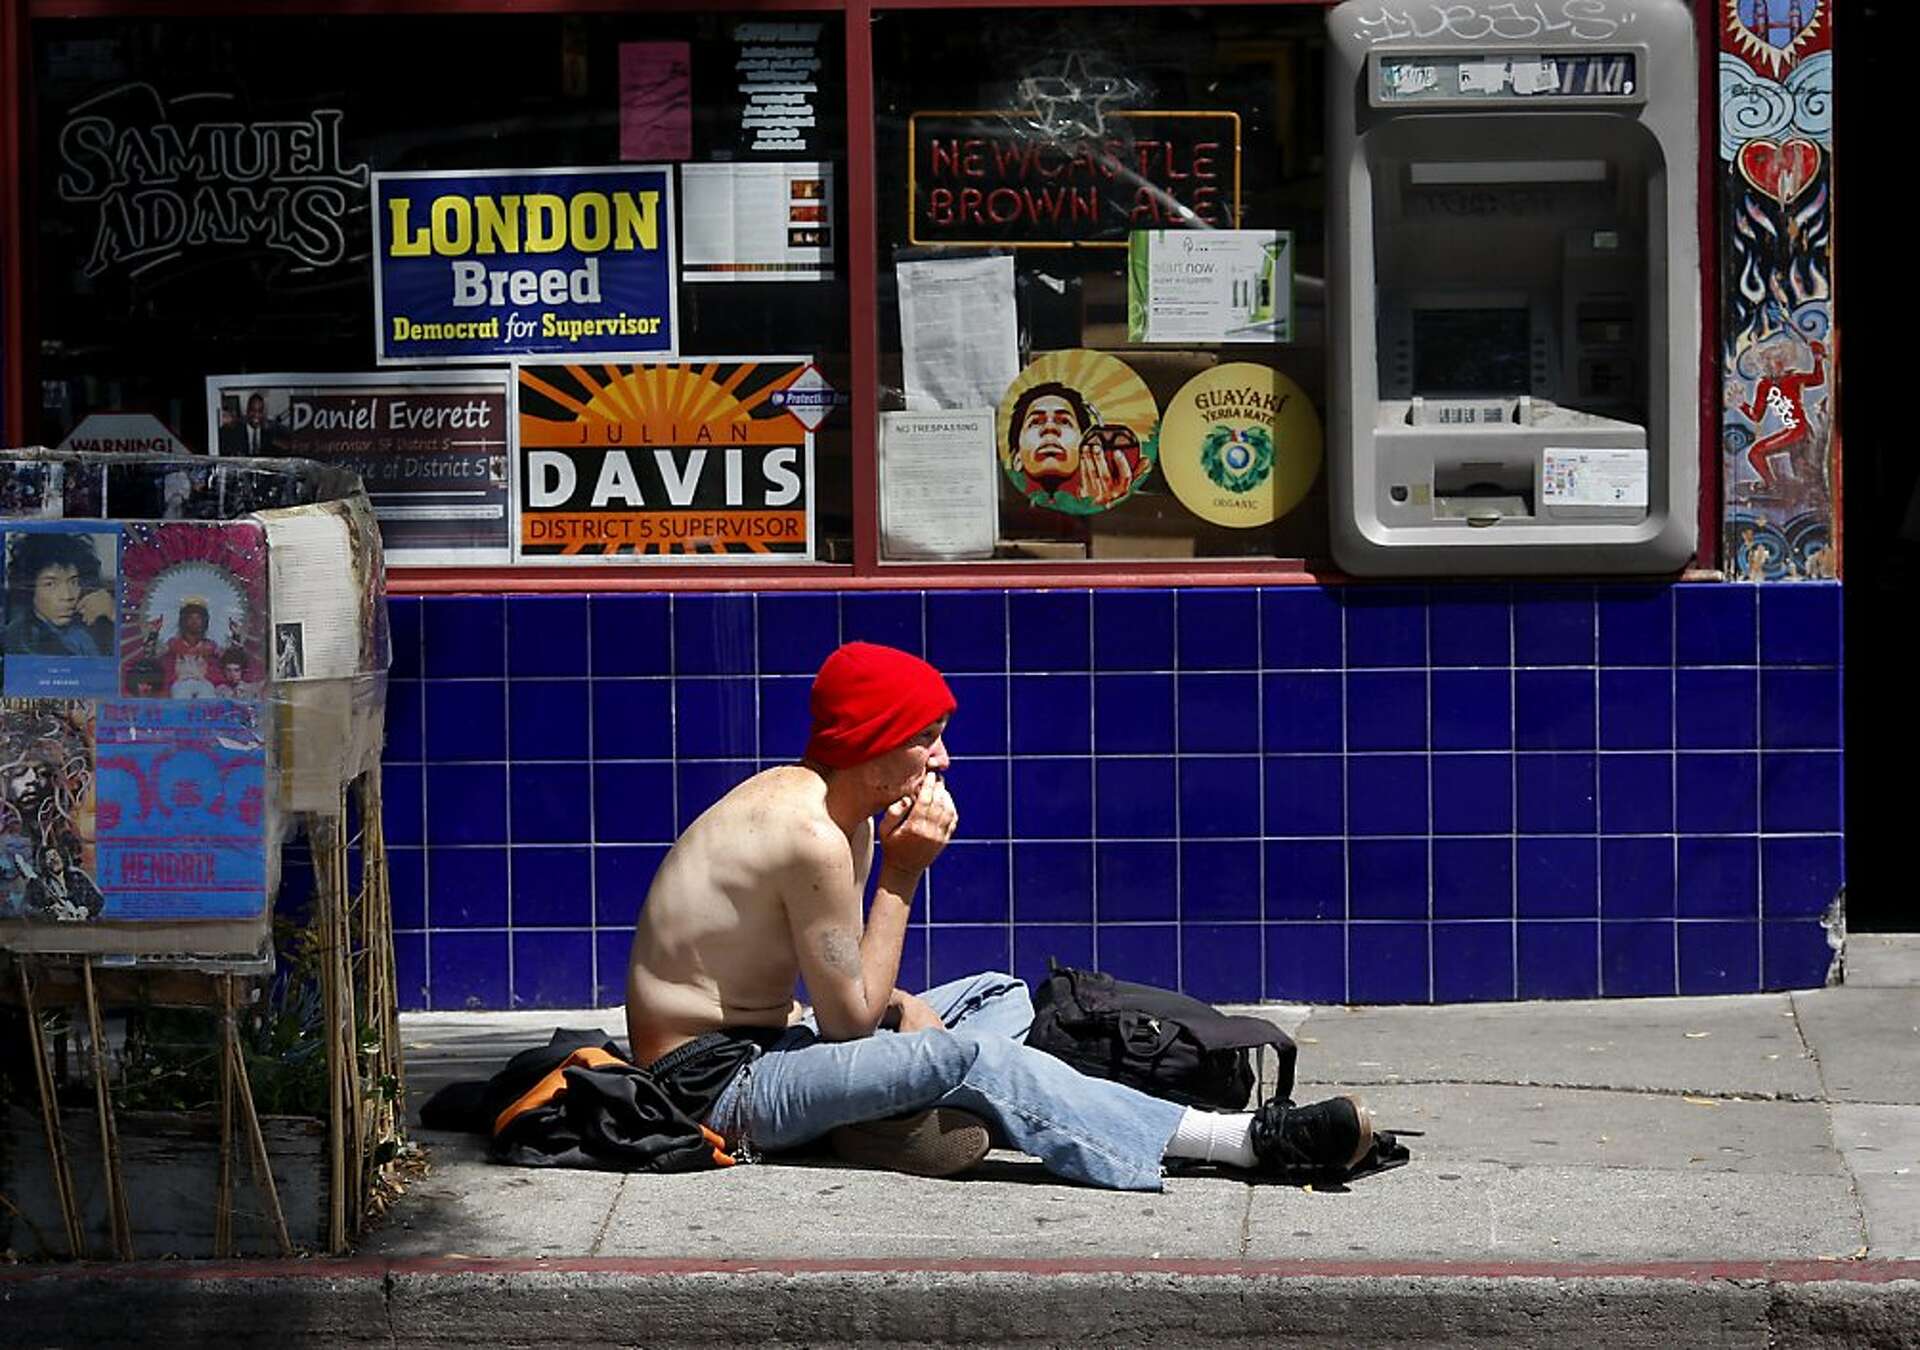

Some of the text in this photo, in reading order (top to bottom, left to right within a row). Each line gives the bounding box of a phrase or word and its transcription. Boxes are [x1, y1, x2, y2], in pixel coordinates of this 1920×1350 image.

[58, 109, 369, 201] SAMUEL
[931, 138, 1220, 182] NEWCASTLE
[929, 186, 1220, 226] BROWN ALE
[85, 185, 345, 278] ADAMS
[389, 190, 660, 257] LONDON
[451, 257, 602, 307] Breed
[393, 312, 661, 344] Democrat for Supervisor
[292, 399, 491, 430] Daniel Everett
[896, 423, 978, 433] NO TRESPASSING
[1243, 408, 1277, 427] MATE
[69, 437, 173, 453] WARNING!
[580, 424, 749, 444] JULIAN
[404, 456, 471, 479] District
[474, 456, 488, 477] 5
[527, 447, 801, 508] DAVIS
[530, 517, 799, 539] DISTRICT 5 SUPERVISOR
